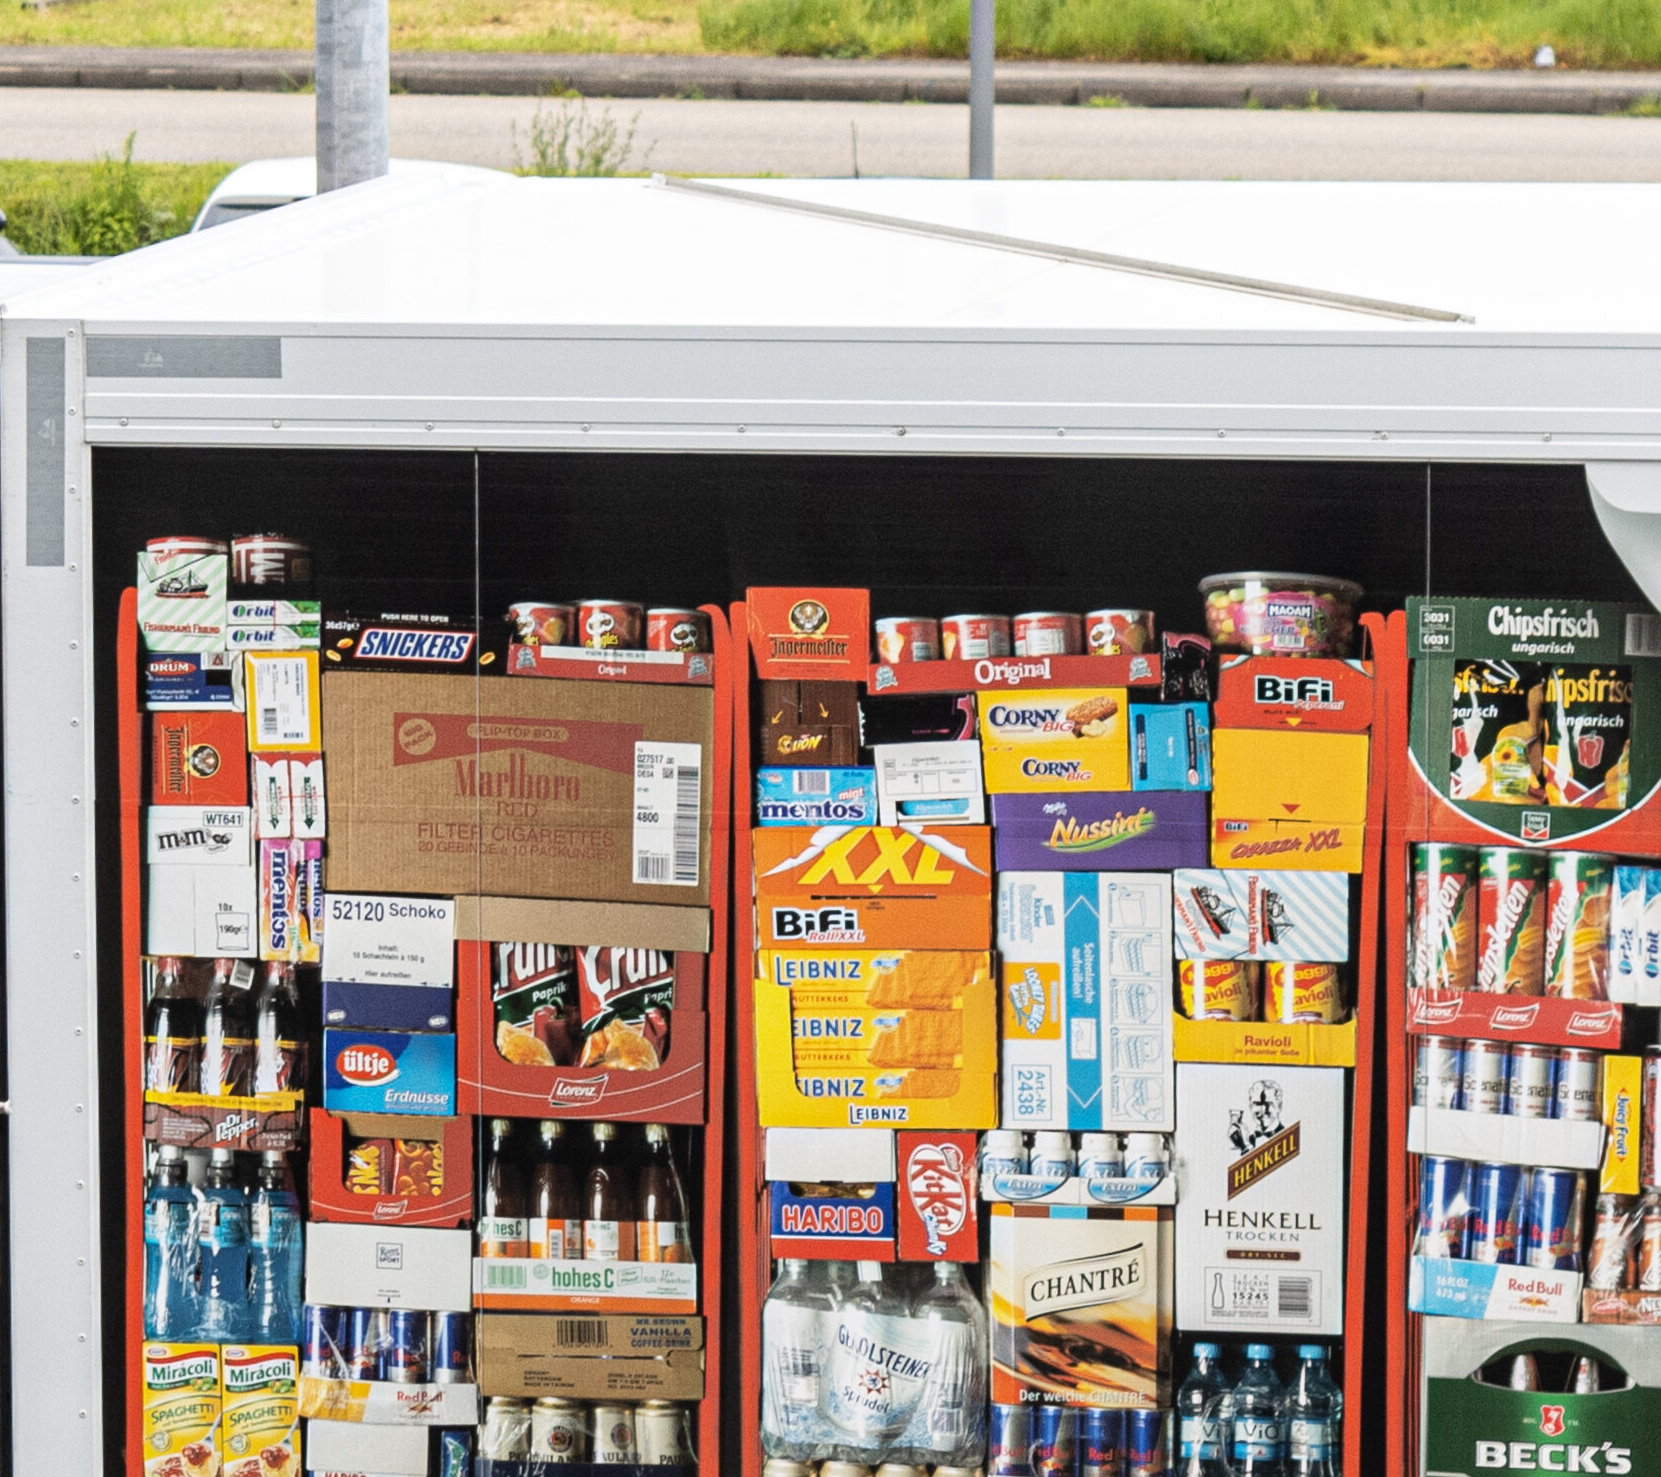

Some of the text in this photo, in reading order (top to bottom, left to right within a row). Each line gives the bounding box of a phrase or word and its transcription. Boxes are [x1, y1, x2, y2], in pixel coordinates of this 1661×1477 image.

[232, 605, 276, 618] Orbit
[381, 613, 397, 621] PUSH
[1268, 604, 1312, 617] MAOAM
[1424, 611, 1449, 624] 3031
[144, 622, 221, 634] FISHERMAN'S FRIEND
[1487, 606, 1600, 641] Chipsfrisch
[232, 629, 276, 643] Orbit
[361, 632, 469, 660] SNICKERS
[1424, 633, 1449, 646] 0031
[770, 637, 848, 658] Jägermeister
[1512, 642, 1575, 656] ungarisch
[150, 662, 189, 672] DRUM
[974, 658, 1051, 684] Original
[1254, 675, 1333, 705] BiFi
[988, 706, 1060, 727] CORNY
[1043, 721, 1074, 732] BIG
[476, 727, 562, 739] FLIP-TOP BOX
[454, 752, 580, 801] Marlboro
[1021, 759, 1080, 776] CORNY
[1066, 771, 1091, 781] BIG
[838, 787, 864, 801] mint
[205, 813, 243, 825] WT641
[497, 801, 538, 818] RED
[636, 812, 659, 822] 4800
[761, 800, 866, 820] mentos
[418, 824, 613, 845] FILTER CIGARETTES
[1050, 807, 1147, 848] Nussini
[1224, 822, 1248, 831] BiFi
[797, 827, 956, 885] XXL
[271, 850, 286, 950] mentos
[332, 900, 446, 922] 52120 Schoko
[773, 909, 857, 939] BiFi
[1645, 929, 1660, 979] Orbit
[775, 956, 861, 986] LEIBNIZ
[1083, 942, 1094, 1004] Seitenlasche
[1496, 1007, 1531, 1023] Lorenz
[1573, 1014, 1608, 1029] Lorenz
[1244, 1035, 1291, 1047] Ravioli
[344, 1049, 390, 1075] ültje
[385, 1089, 449, 1106] Erdnüsse
[556, 1081, 597, 1099] Lorenz
[1017, 1069, 1034, 1116] 2438
[1034, 1071, 1048, 1117] Art.-Nr.
[849, 1104, 908, 1124] LEIBNIZ
[215, 1117, 258, 1143] Pepper
[1234, 1132, 1298, 1188] HENKELL
[781, 1205, 884, 1233] HARIBO
[1204, 1209, 1322, 1230] HENKELL
[1225, 1230, 1300, 1242] TROCKEN
[552, 1267, 614, 1288] hohes C
[1030, 1259, 1141, 1303] CHANTRÉ
[1507, 1277, 1564, 1298] Red Bull
[630, 1328, 692, 1336] VANILLA
[152, 1359, 213, 1382] Mirácoli
[230, 1361, 291, 1384] Mirácoli
[1019, 1389, 1036, 1402] Der
[1038, 1390, 1087, 1403] weiche
[150, 1403, 215, 1425] SPAGHETTI
[229, 1405, 293, 1427] SPAGHETTI
[1475, 1440, 1632, 1474] BECK'S
